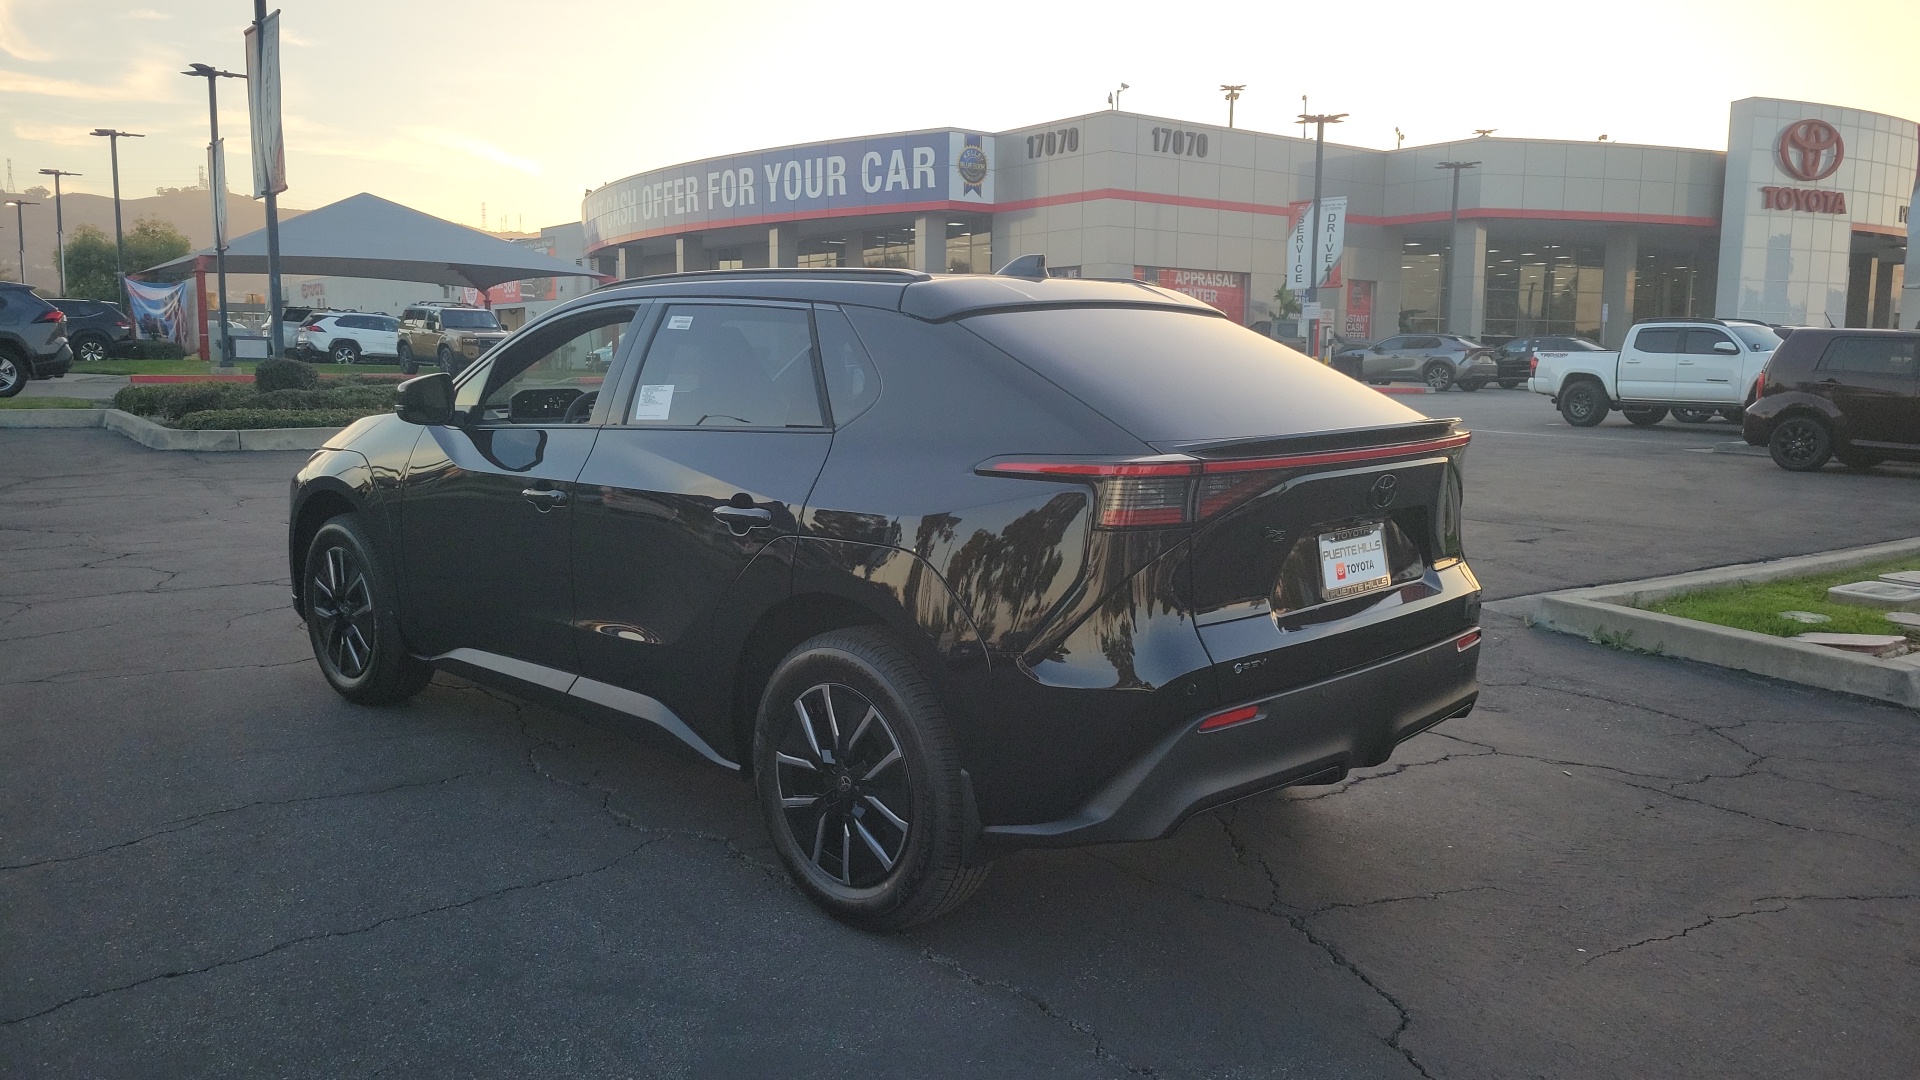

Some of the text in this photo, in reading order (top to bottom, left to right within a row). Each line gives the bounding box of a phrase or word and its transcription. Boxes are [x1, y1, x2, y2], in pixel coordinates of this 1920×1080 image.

[1026, 127, 1079, 159] 17070
[1152, 126, 1209, 158] 17070
[606, 189, 637, 229] CASH
[642, 176, 699, 220] OFFER
[707, 167, 755, 210] FOR
[764, 155, 847, 202] YOUR
[861, 146, 936, 194] CAR
[1761, 186, 1847, 214] TOYOTA
[1295, 215, 1305, 283] SERVICE
[1325, 213, 1337, 263] DRIVE
[1067, 269, 1078, 278] WE
[1174, 271, 1236, 288] APPRAISAL
[1175, 287, 1218, 303] ENTER
[1346, 323, 1365, 332] CASH
[1336, 527, 1369, 540] TOYOTA
[1322, 540, 1381, 562] PUENTE HILLS
[1346, 560, 1375, 575] TOYOTA
[1329, 577, 1388, 599] PUENTE HILLS
